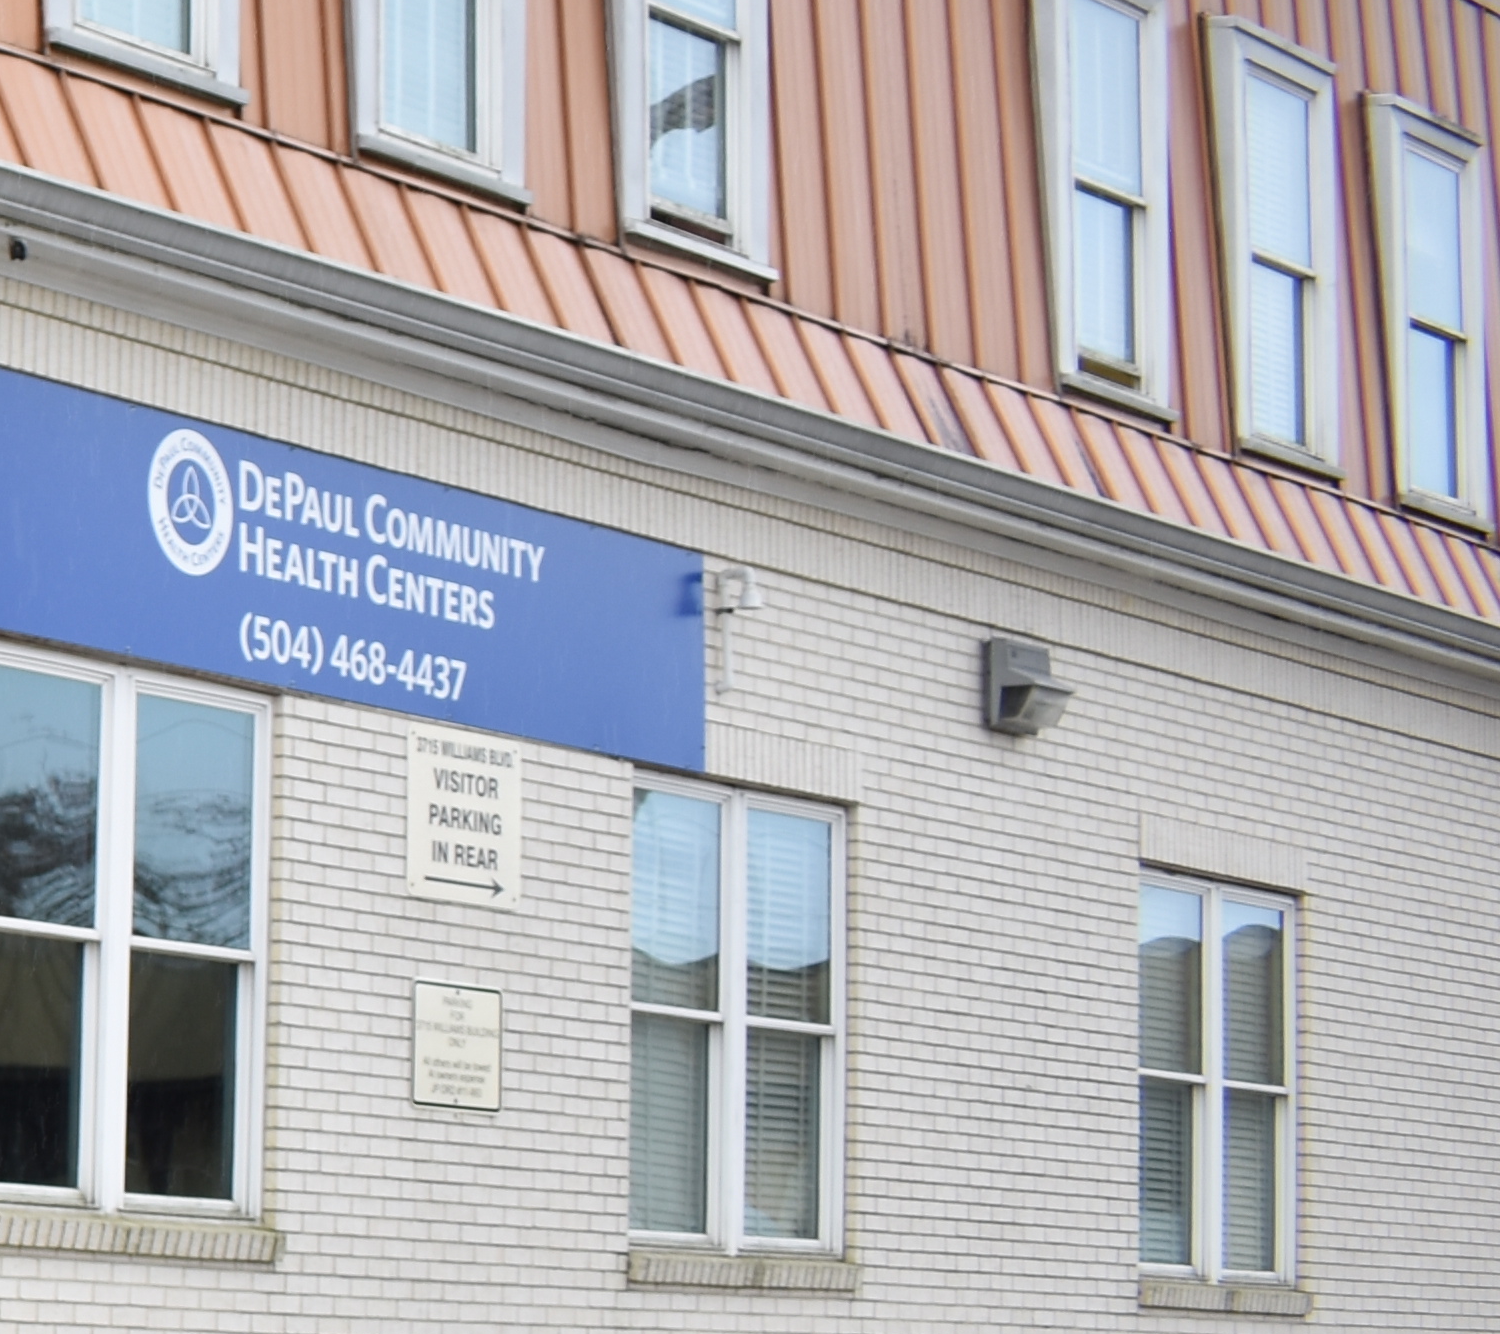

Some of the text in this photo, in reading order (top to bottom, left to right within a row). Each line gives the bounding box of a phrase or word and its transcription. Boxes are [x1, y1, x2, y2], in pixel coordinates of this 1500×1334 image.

[365, 494, 546, 584] COMMUNITY
[238, 522, 495, 631] HEALTH CENTERS
[239, 612, 467, 702] (504) 468-4437
[441, 740, 487, 763] WILLIAMS
[433, 767, 498, 799] VISITOR
[428, 803, 502, 835] PARKING
[432, 840, 499, 870] IN REAR
